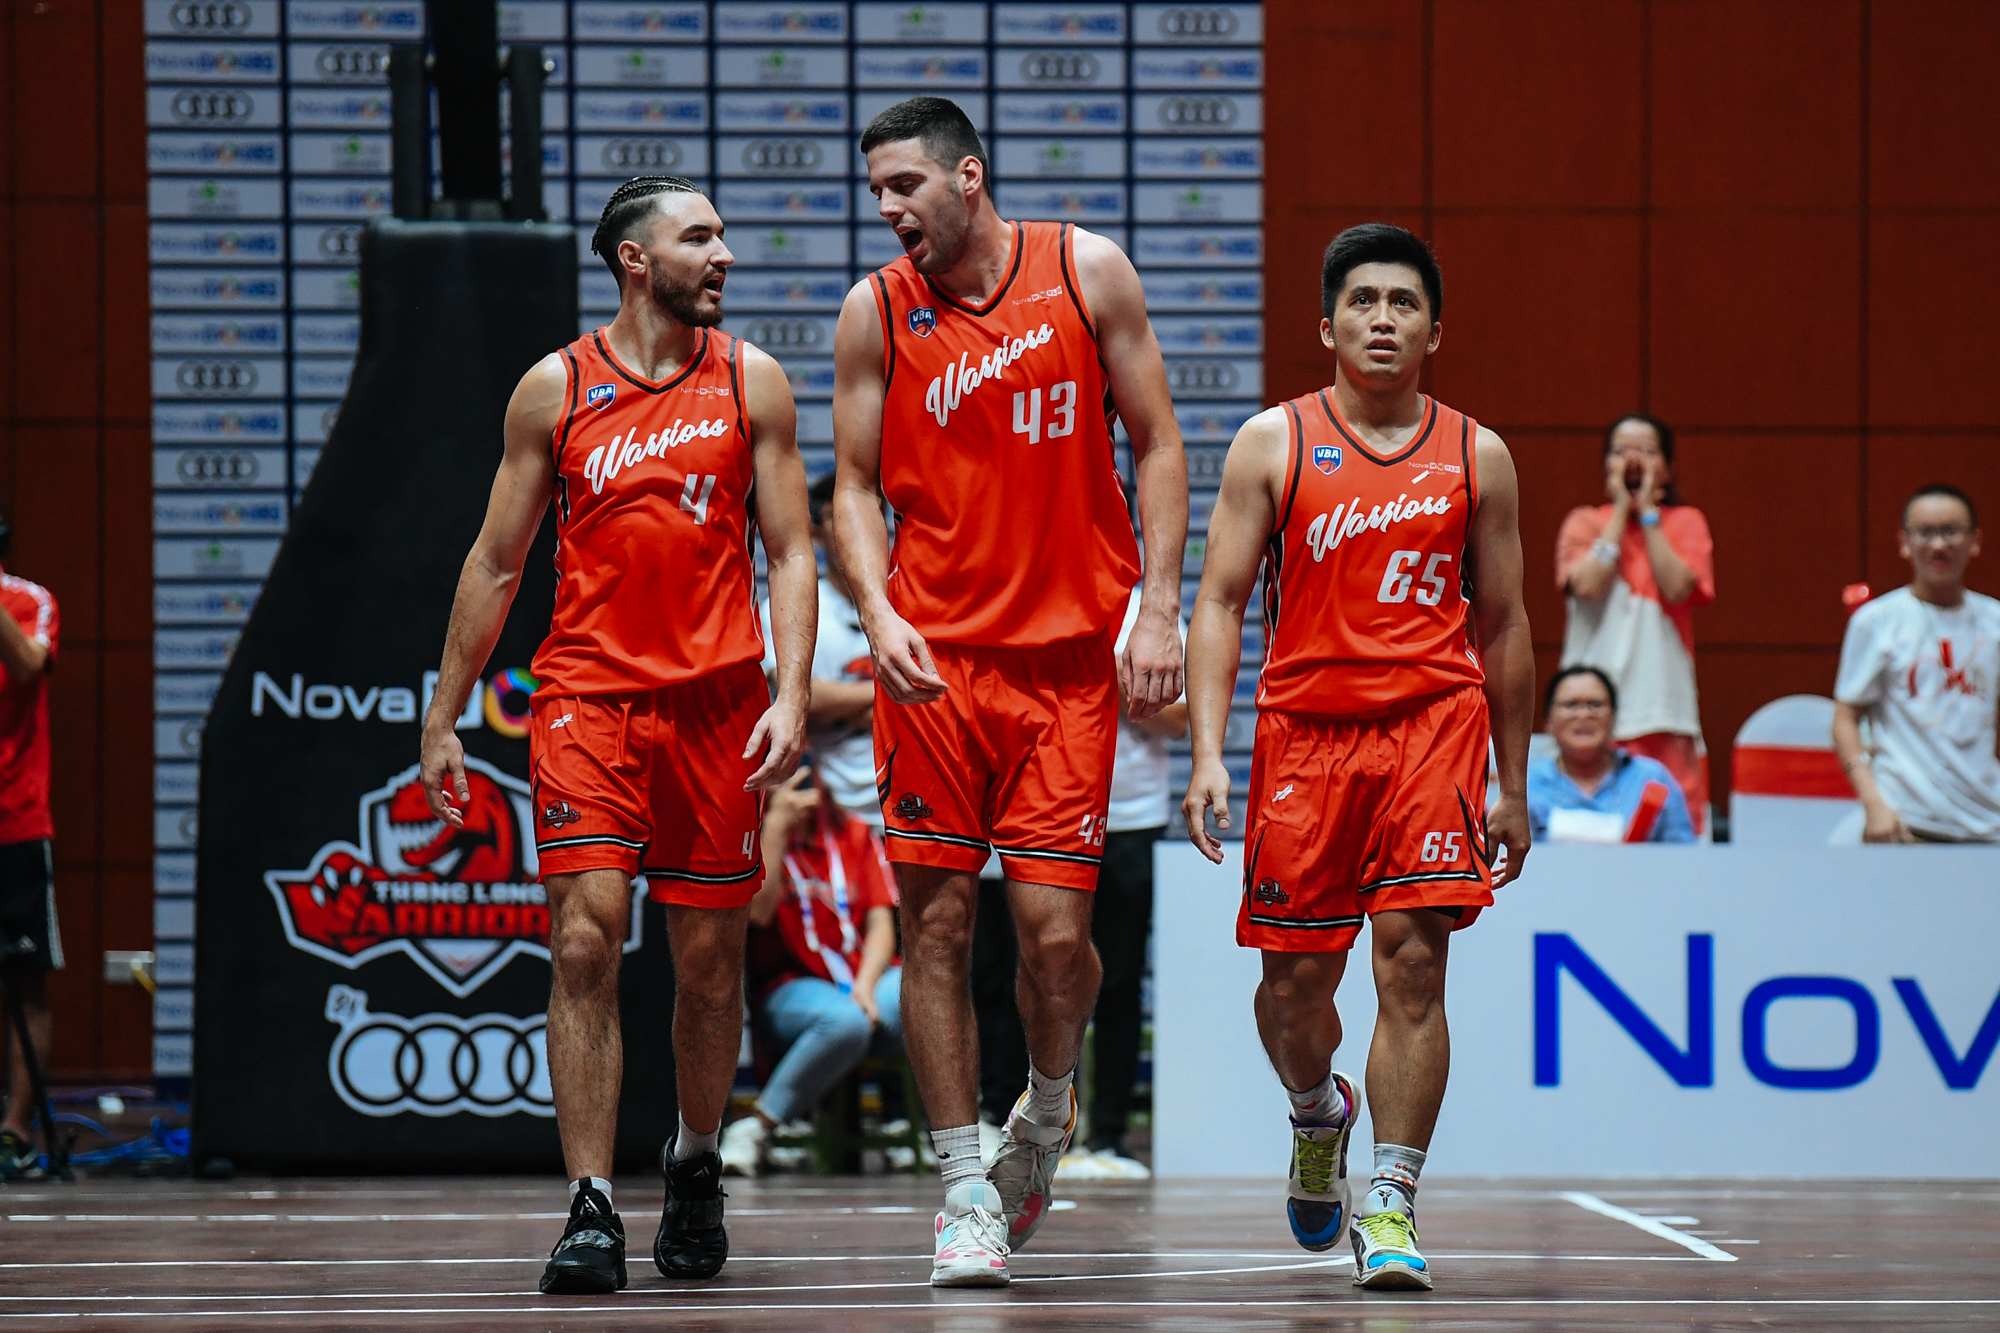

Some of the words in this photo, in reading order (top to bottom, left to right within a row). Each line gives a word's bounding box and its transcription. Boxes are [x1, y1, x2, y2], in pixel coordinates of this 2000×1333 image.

[912, 310, 932, 322] VBA
[590, 386, 613, 399] VBA
[925, 323, 1055, 427] Warriors
[1012, 380, 1077, 445] 43
[583, 418, 729, 495] Warriors
[1316, 448, 1340, 459] VBA
[679, 473, 717, 526] 4
[1306, 493, 1452, 563] Warriors
[1377, 550, 1453, 606] 65
[741, 829, 756, 861] 4
[1077, 814, 1106, 847] 43
[1420, 831, 1463, 863] 65
